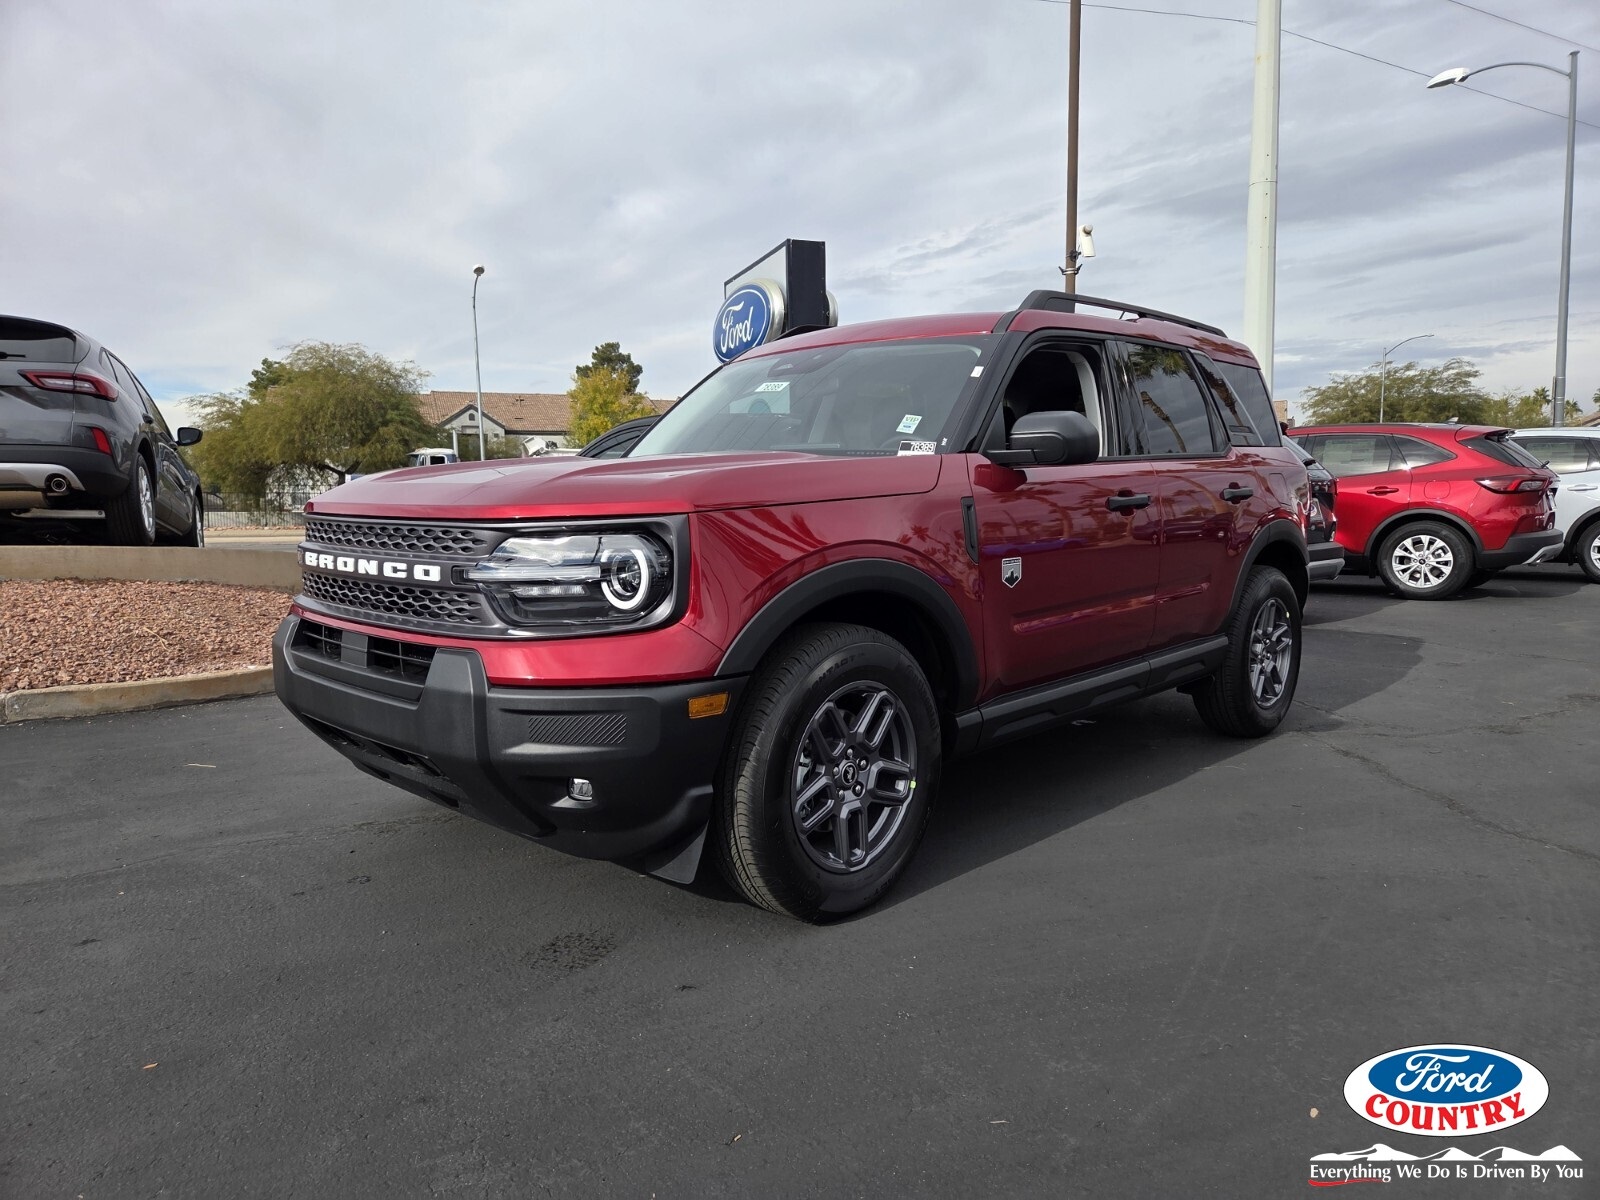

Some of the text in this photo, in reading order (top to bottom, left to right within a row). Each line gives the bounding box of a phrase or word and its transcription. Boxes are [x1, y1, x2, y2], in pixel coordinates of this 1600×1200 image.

[720, 300, 754, 354] Ford
[910, 442, 934, 453] 78389
[304, 551, 441, 582] BRONCO
